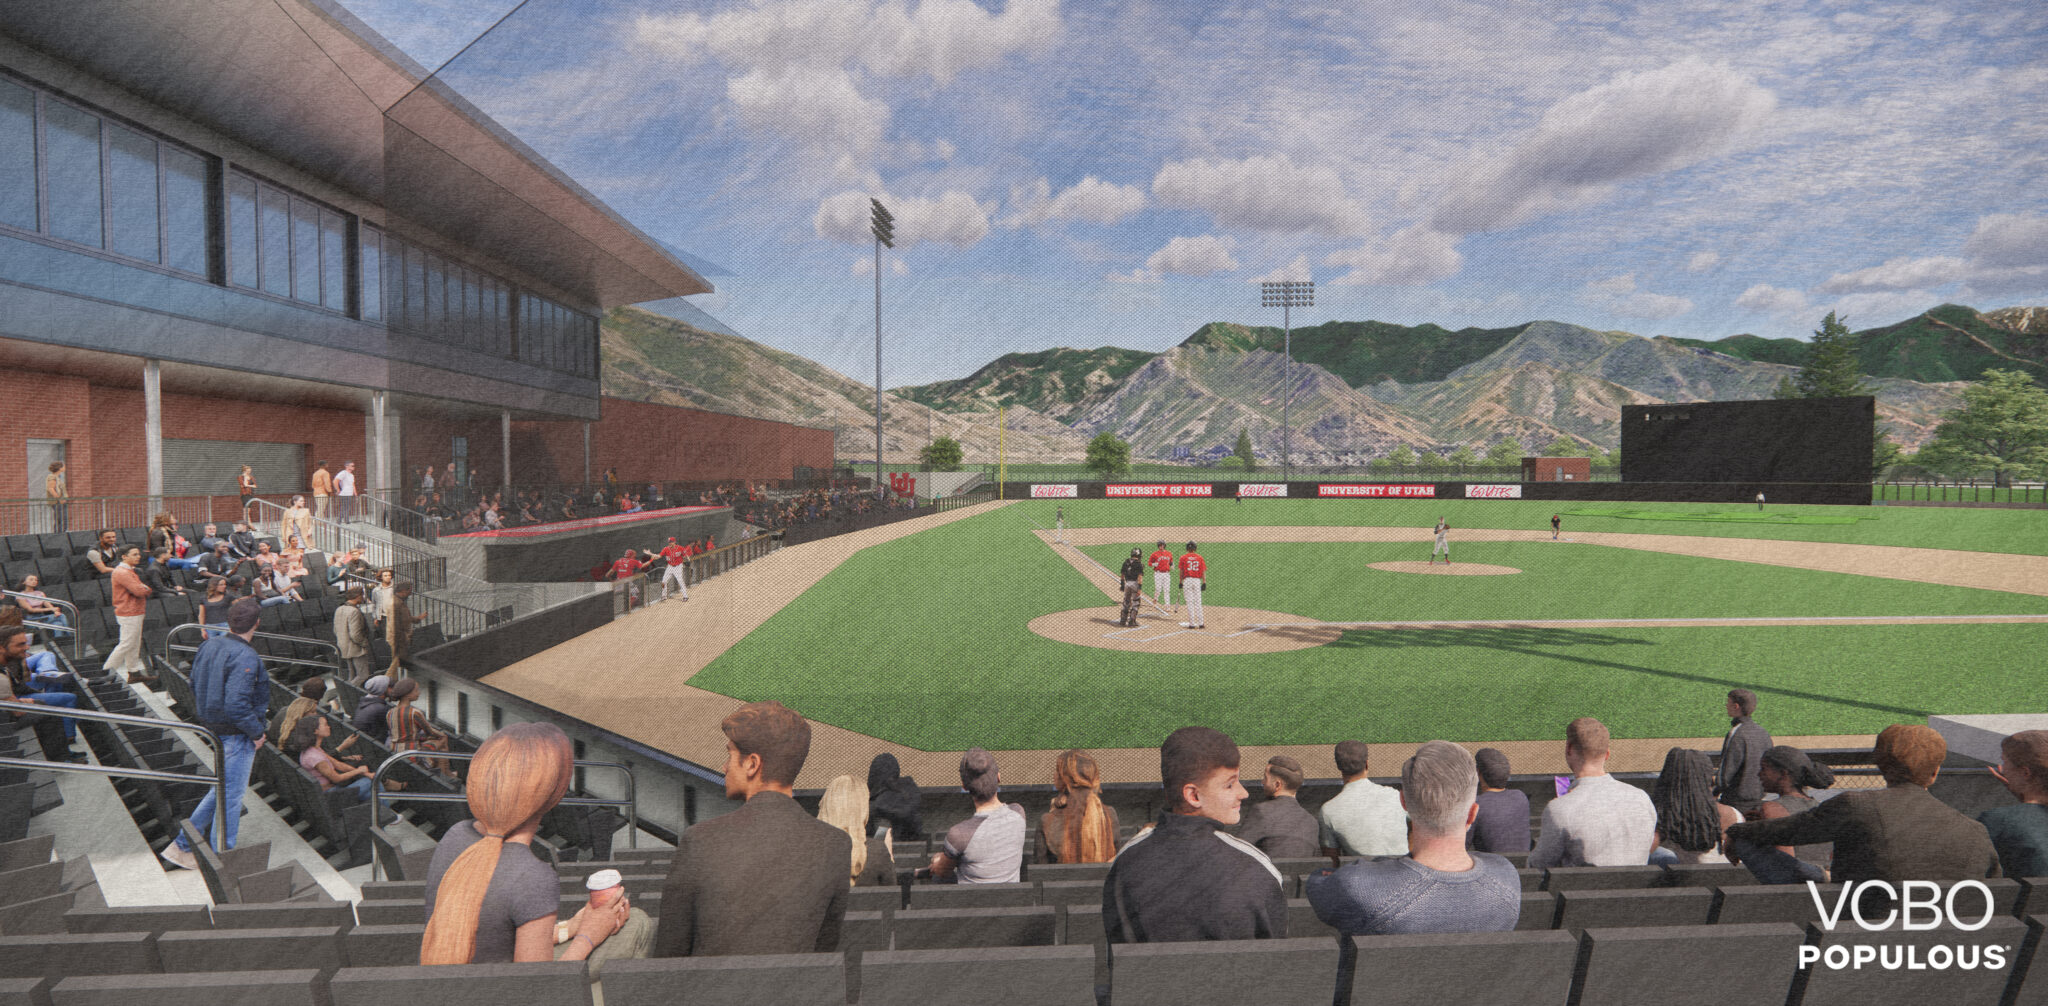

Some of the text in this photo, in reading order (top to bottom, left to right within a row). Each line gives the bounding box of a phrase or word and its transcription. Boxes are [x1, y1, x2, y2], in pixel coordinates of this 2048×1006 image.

[1106, 485, 1212, 495] UNIVERSITY OF UTAH
[1319, 486, 1435, 496] UNIVERSITY OF UTAH
[1186, 560, 1200, 572] 32
